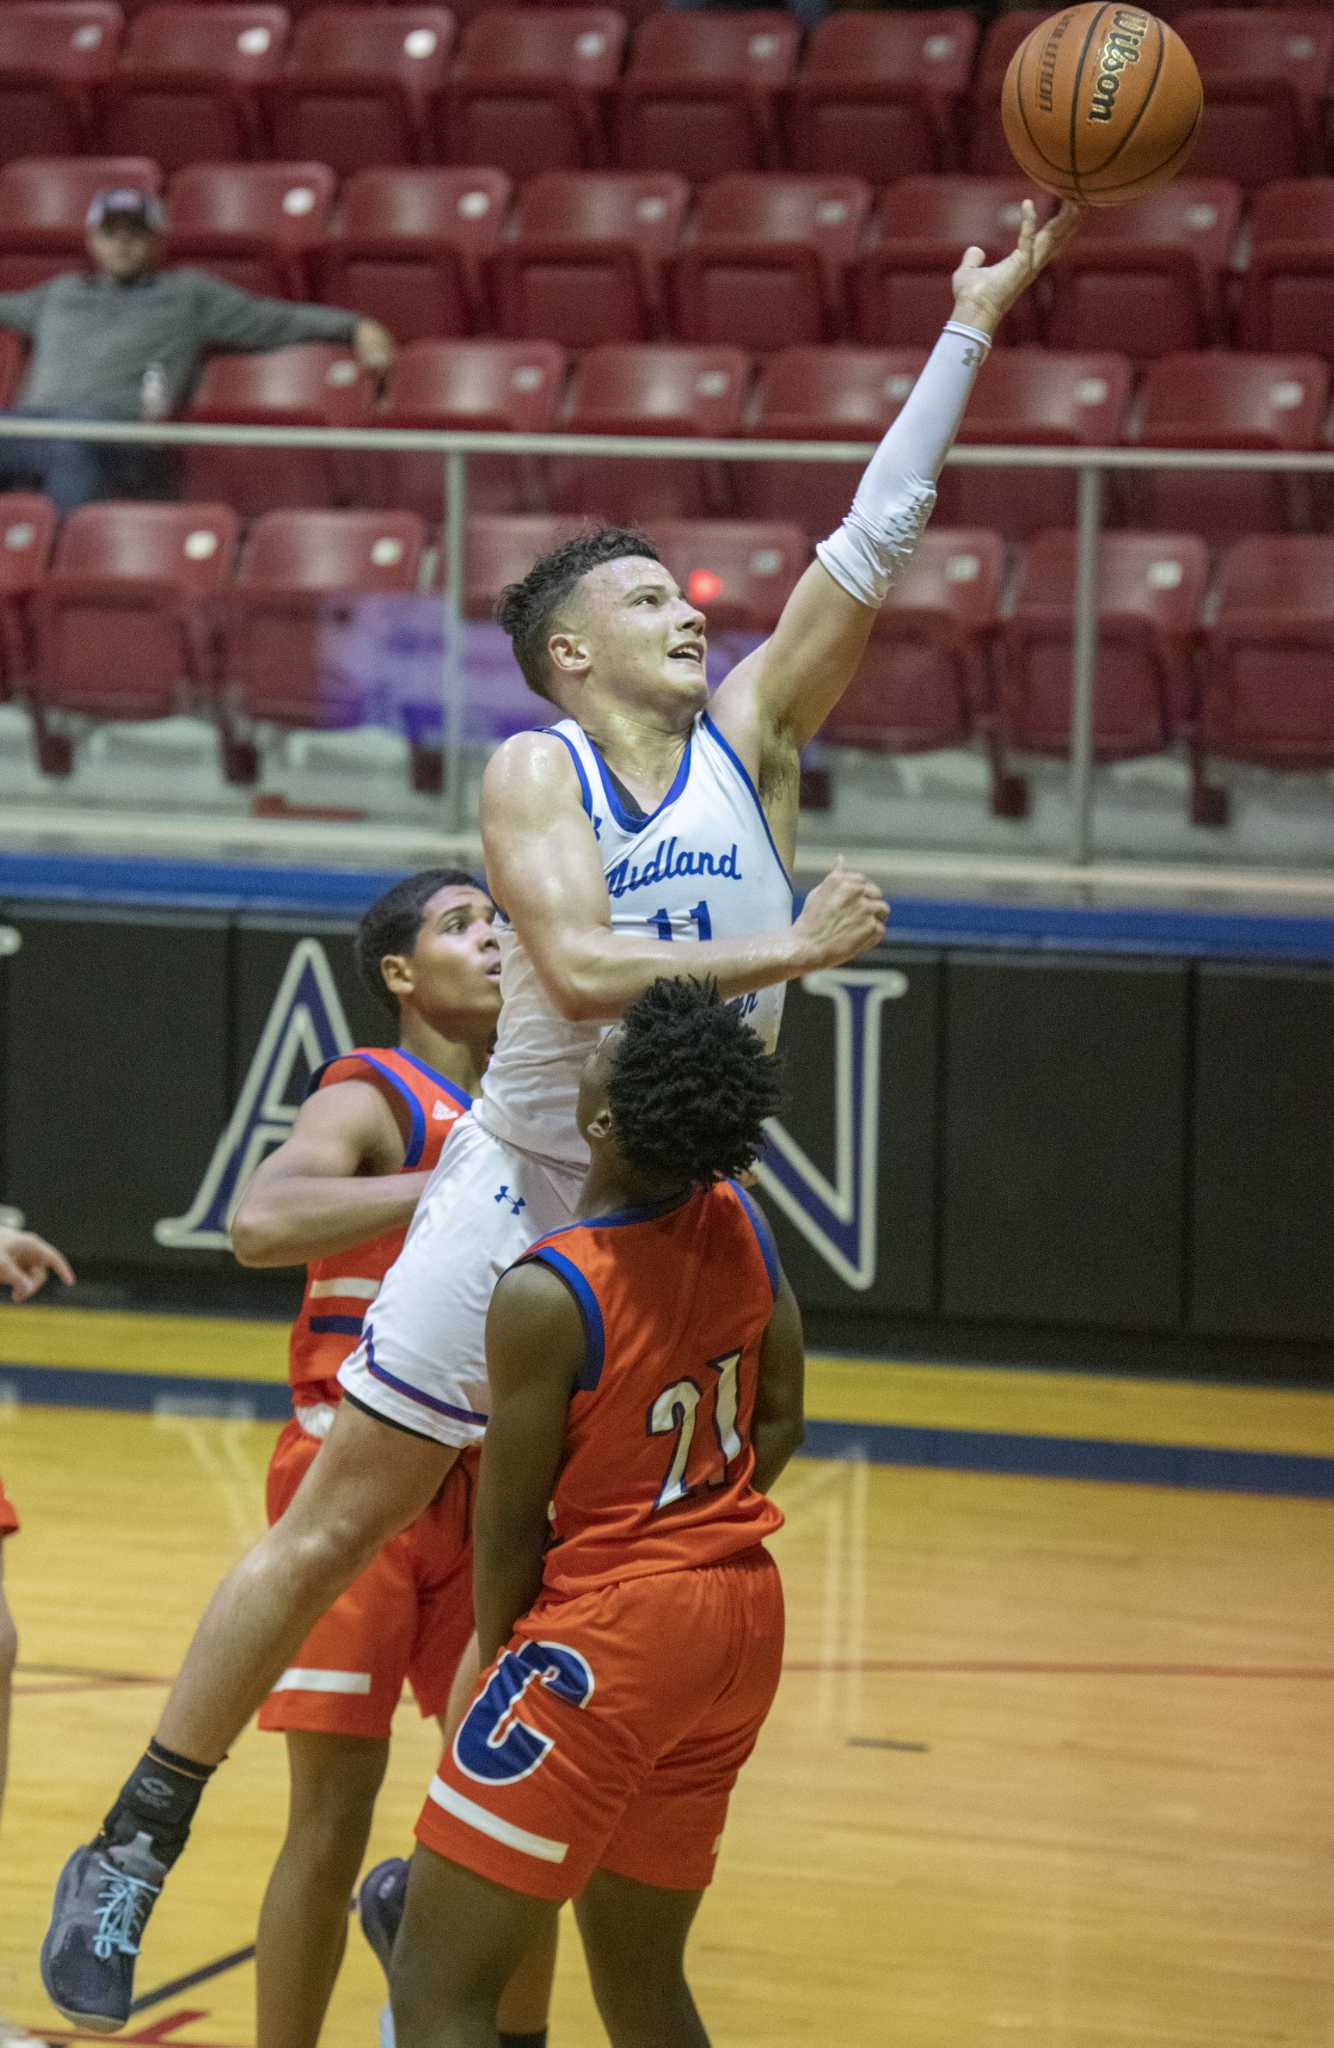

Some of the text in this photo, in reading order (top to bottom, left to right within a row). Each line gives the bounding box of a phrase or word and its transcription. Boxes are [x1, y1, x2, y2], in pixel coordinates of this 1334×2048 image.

[1087, 9, 1148, 124] Wilson
[605, 836, 742, 898] Midland
[646, 1347, 744, 1510] 21
